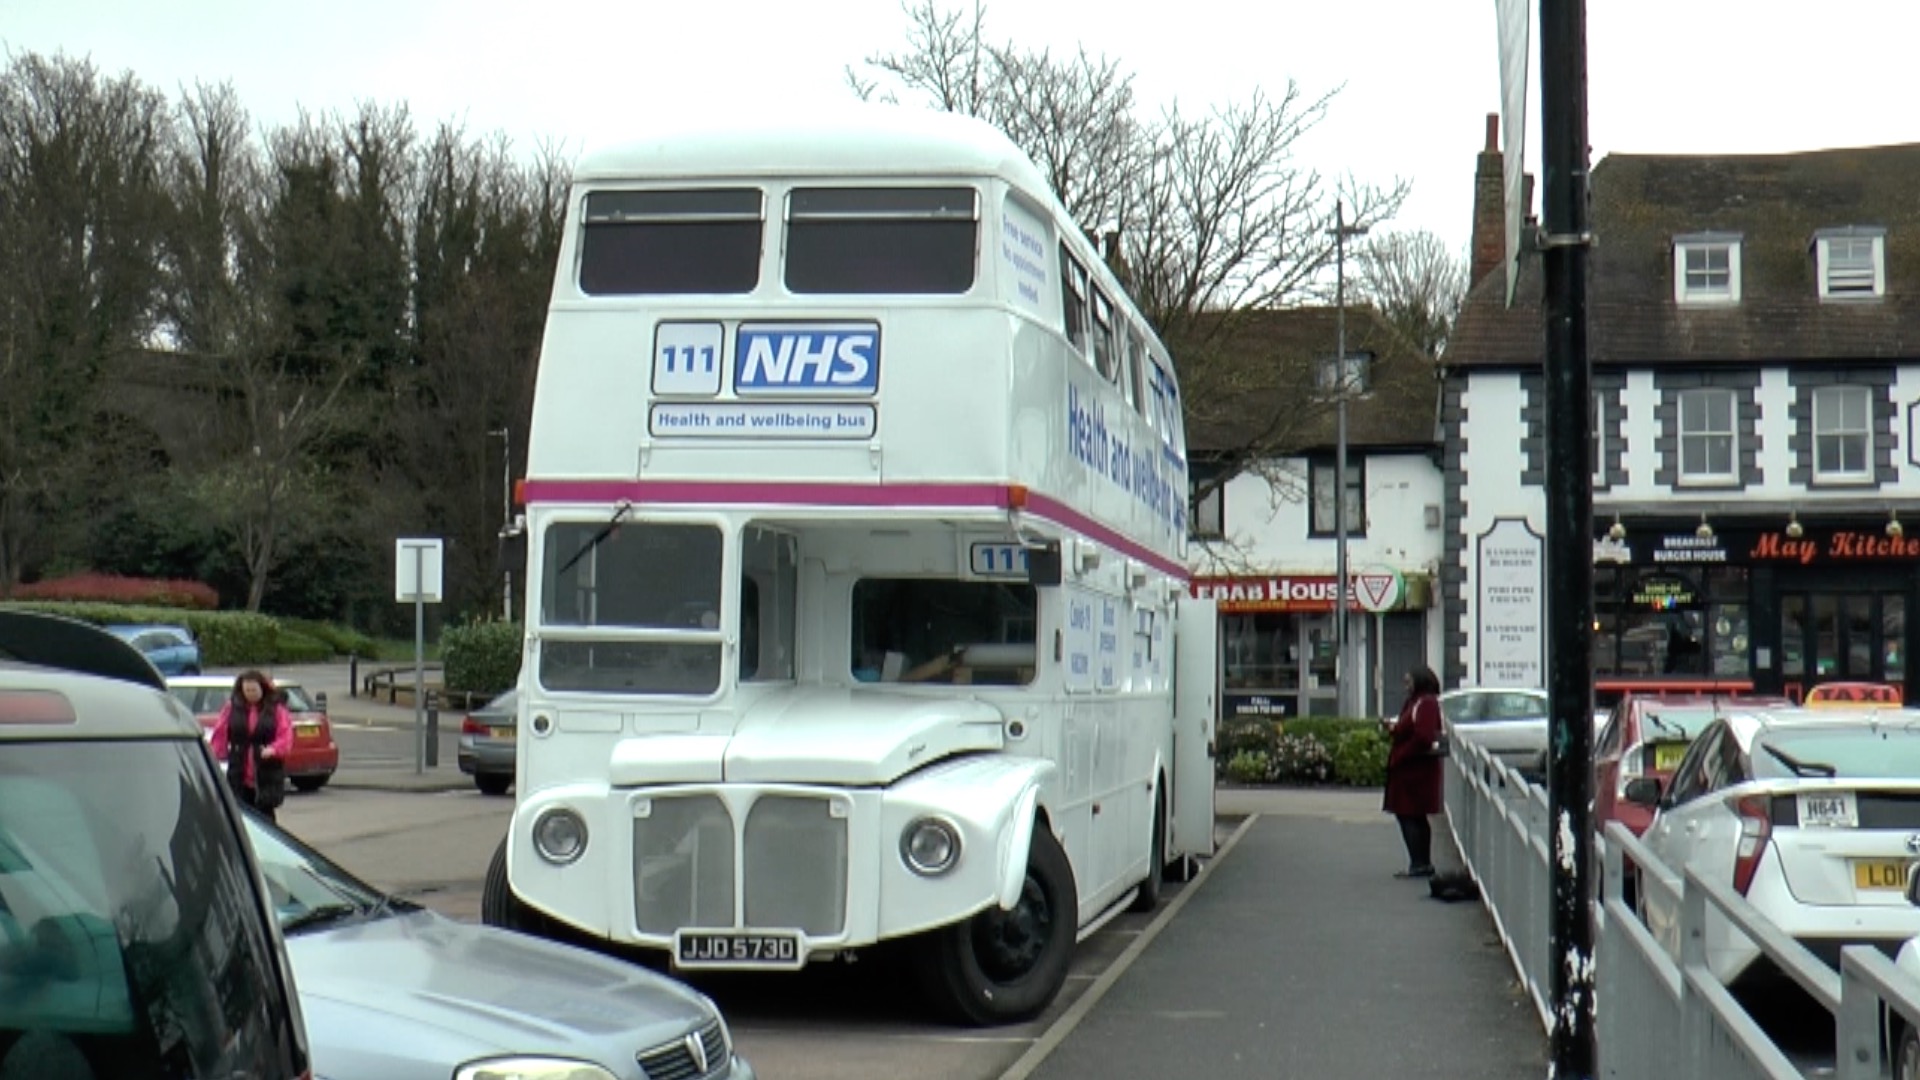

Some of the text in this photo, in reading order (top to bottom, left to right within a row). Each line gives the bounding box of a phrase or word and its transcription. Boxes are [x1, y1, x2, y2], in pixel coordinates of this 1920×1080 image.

[662, 345, 714, 373] 111
[740, 334, 873, 383] NHS
[658, 413, 866, 429] Health and wellbeing bus
[1069, 381, 1109, 479] Health
[1111, 427, 1131, 492] and
[982, 547, 1030, 571] 111
[1653, 549, 1727, 561] BURGER HOUSE
[1750, 532, 1920, 565] May Kitche
[1189, 583, 1264, 601] EBAB
[1820, 688, 1891, 701] TAXI
[683, 936, 794, 959] JJD 573D
